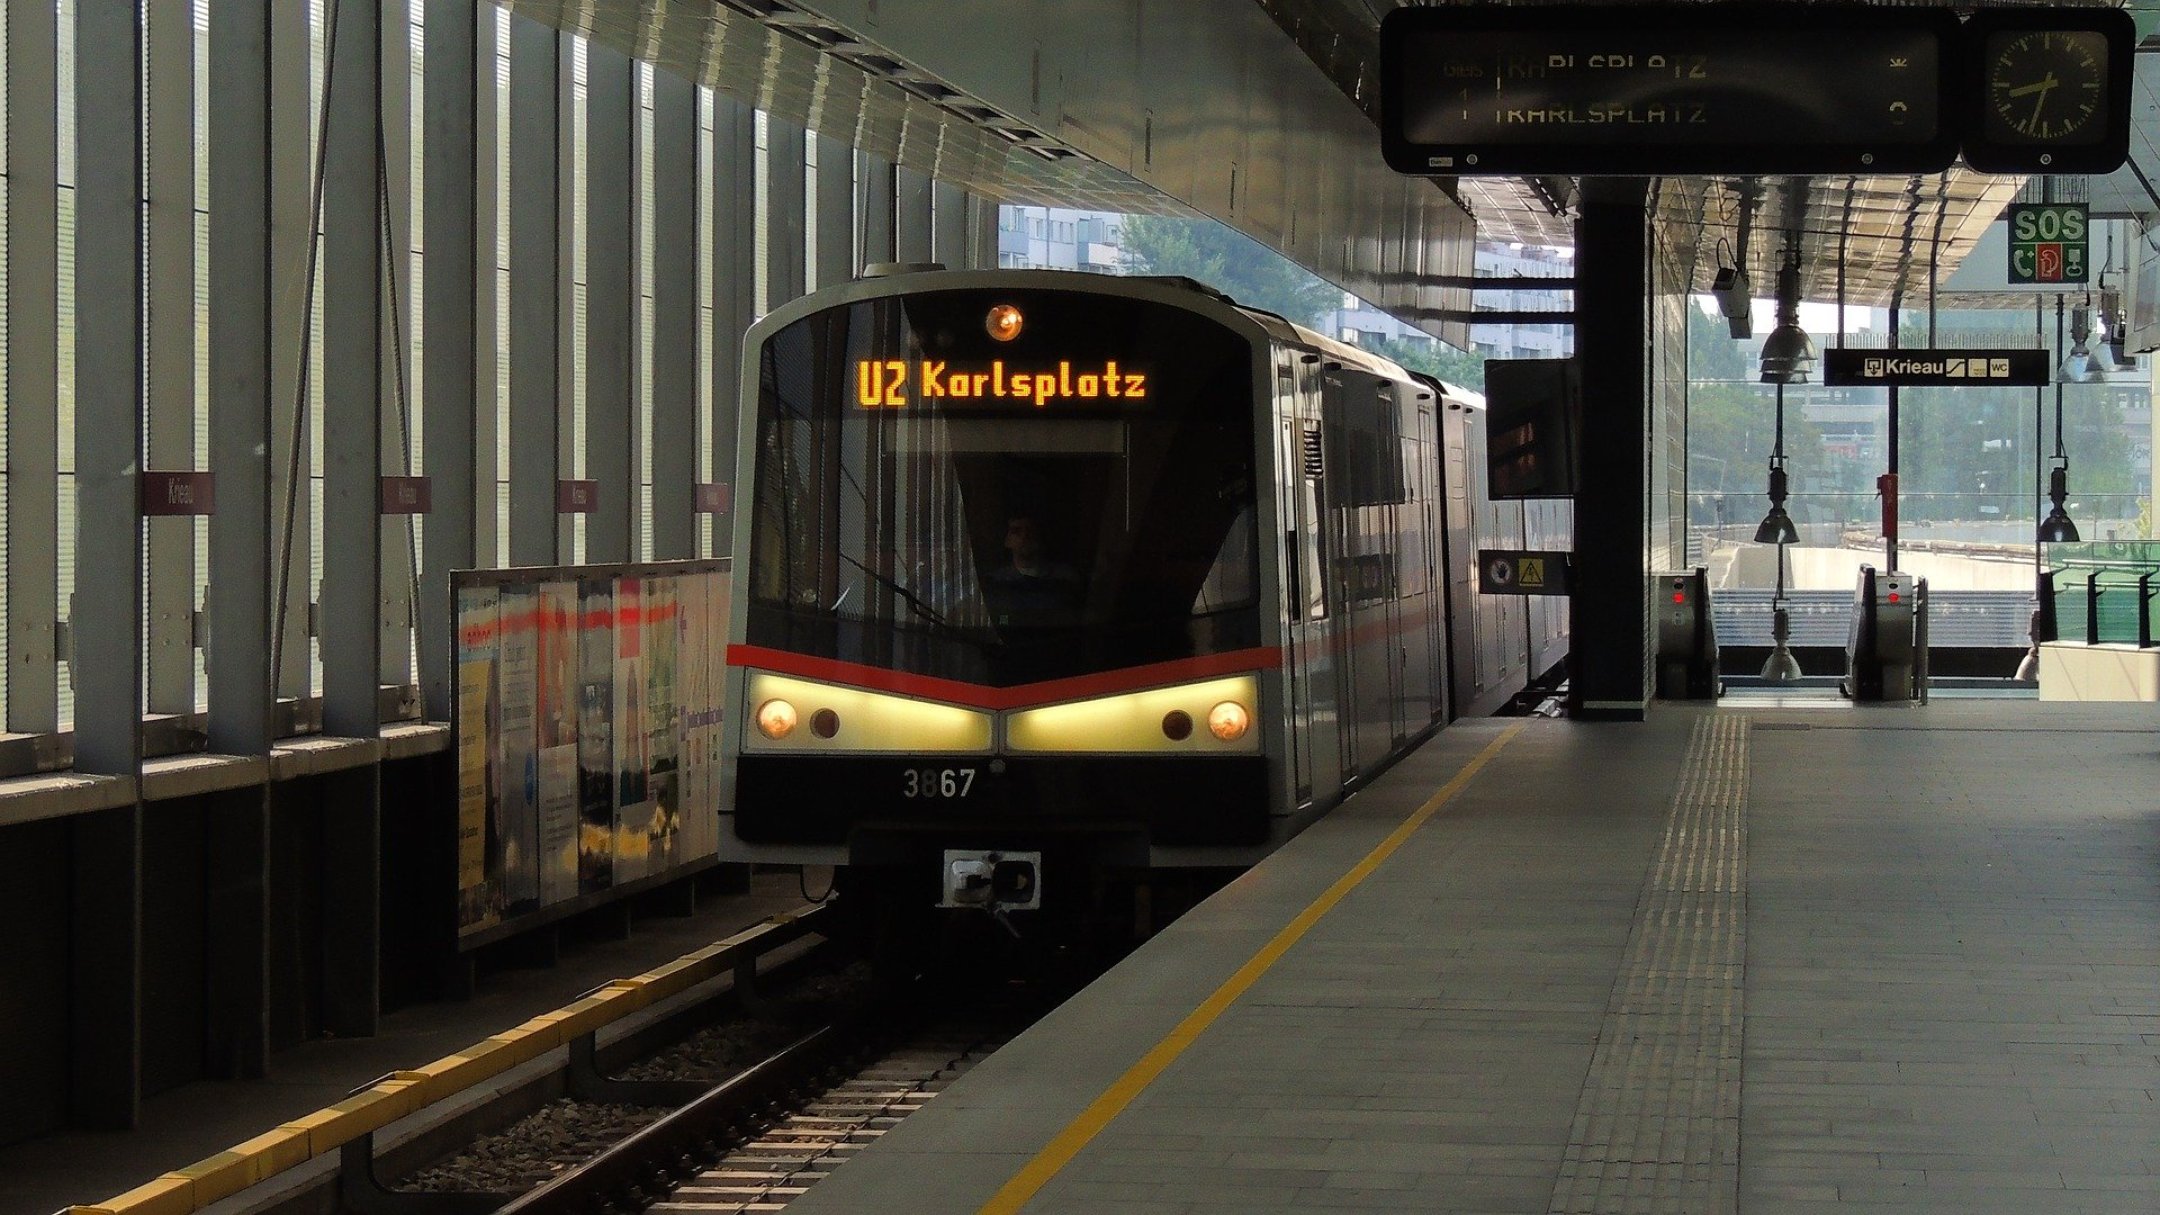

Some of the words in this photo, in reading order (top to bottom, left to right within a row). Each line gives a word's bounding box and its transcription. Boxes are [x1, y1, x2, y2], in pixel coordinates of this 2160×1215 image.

[2014, 209, 2085, 241] SOS
[1886, 358, 1944, 375] Krieau
[1991, 363, 2008, 372] WC
[859, 361, 907, 406] U2
[922, 361, 1146, 406] Karlsplatz
[903, 767, 976, 799] 3867
